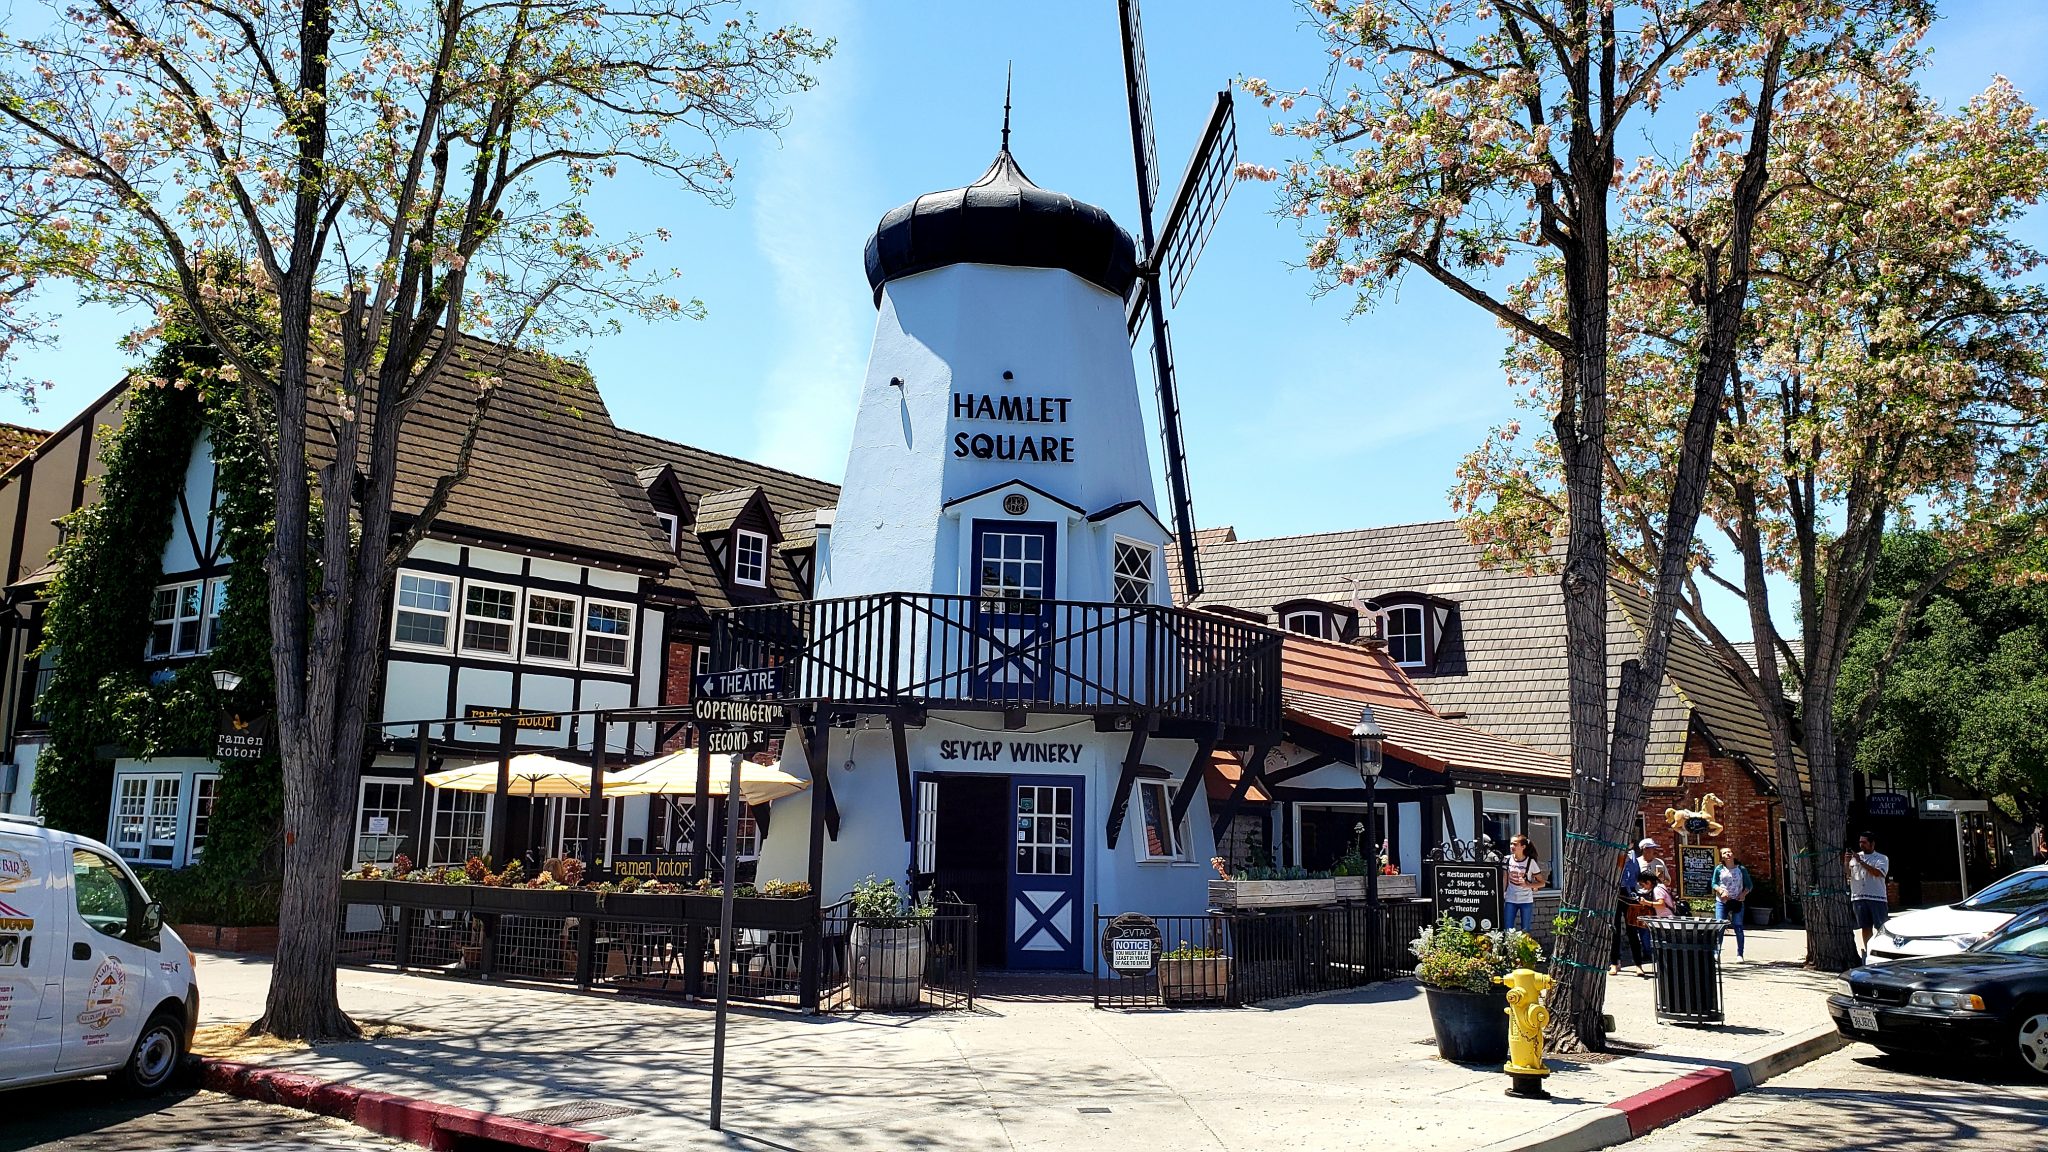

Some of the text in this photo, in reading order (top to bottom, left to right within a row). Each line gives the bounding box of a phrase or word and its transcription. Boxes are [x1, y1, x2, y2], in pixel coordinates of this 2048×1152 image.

[954, 393, 1072, 422] HAMLET
[954, 432, 1075, 463] SQUARE
[719, 671, 776, 695] THEATRE
[696, 700, 773, 723] COPENHAGEN
[218, 734, 264, 746] ramen
[708, 730, 764, 752] SECOND ST.
[216, 744, 262, 759] kotori
[939, 739, 1083, 763] SEVTAP WINERY
[2, 859, 20, 875] BAR
[614, 857, 693, 877] ramen kotori
[1444, 888, 1467, 896] Tasting
[1456, 880, 1475, 888] Shops
[1115, 941, 1149, 950] NOTICE
